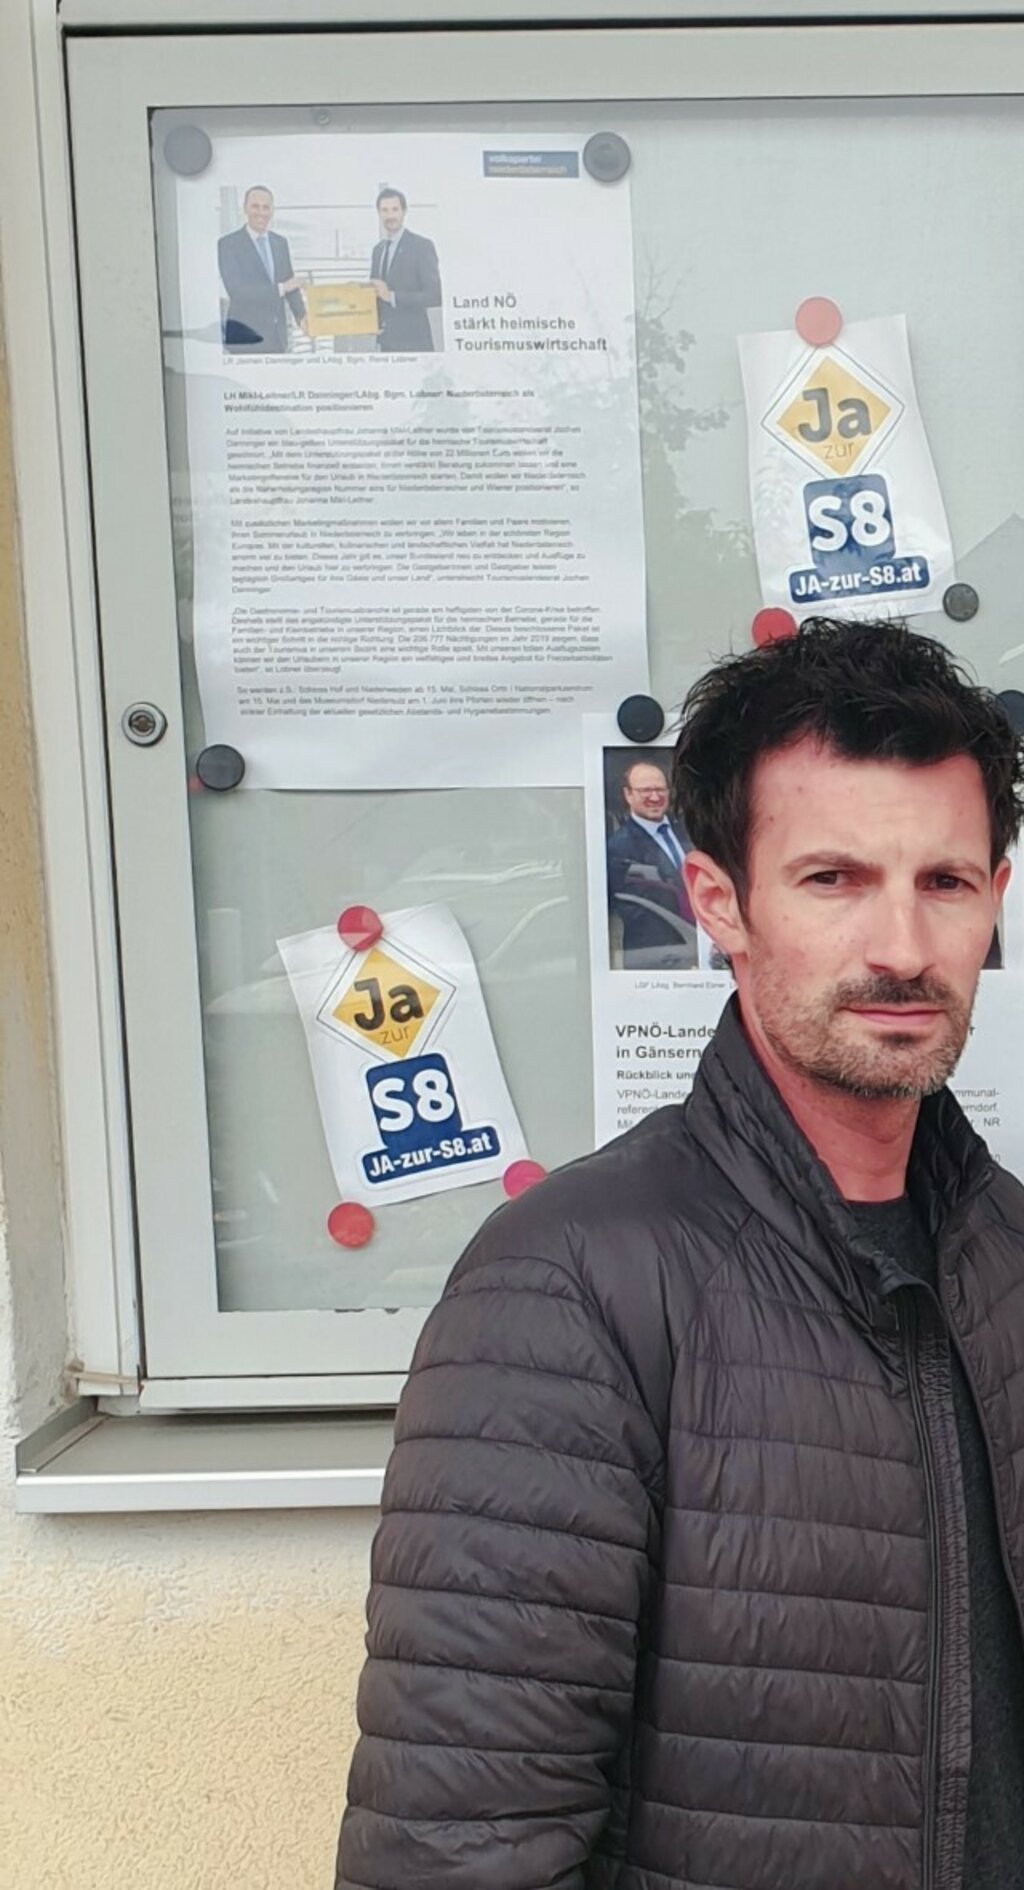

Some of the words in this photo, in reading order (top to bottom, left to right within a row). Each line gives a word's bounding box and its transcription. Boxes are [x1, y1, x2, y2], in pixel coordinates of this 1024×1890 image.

[453, 296, 488, 309] Land
[494, 292, 516, 309] NÖ
[454, 316, 496, 330] stärkt
[500, 316, 575, 330] heimische
[456, 338, 607, 352] Tourismuswirtschaft
[797, 387, 872, 443] Ja
[823, 441, 855, 460] zur
[809, 490, 890, 551] S8
[795, 564, 921, 595] JA-zur-S8.at
[353, 977, 424, 1031] Ja
[379, 1026, 411, 1045] zur
[615, 1023, 717, 1038] VPNÖ-Lande
[616, 1045, 630, 1059] in
[635, 1045, 702, 1059] Gänsern
[617, 1070, 673, 1080] Rückblick
[372, 1068, 455, 1132] S8
[617, 1089, 688, 1100] VPNÖ-Lande
[955, 1088, 999, 1097] mmunal-
[983, 1118, 1000, 1127] NR
[369, 1132, 492, 1178] JA-zur-S8.at
